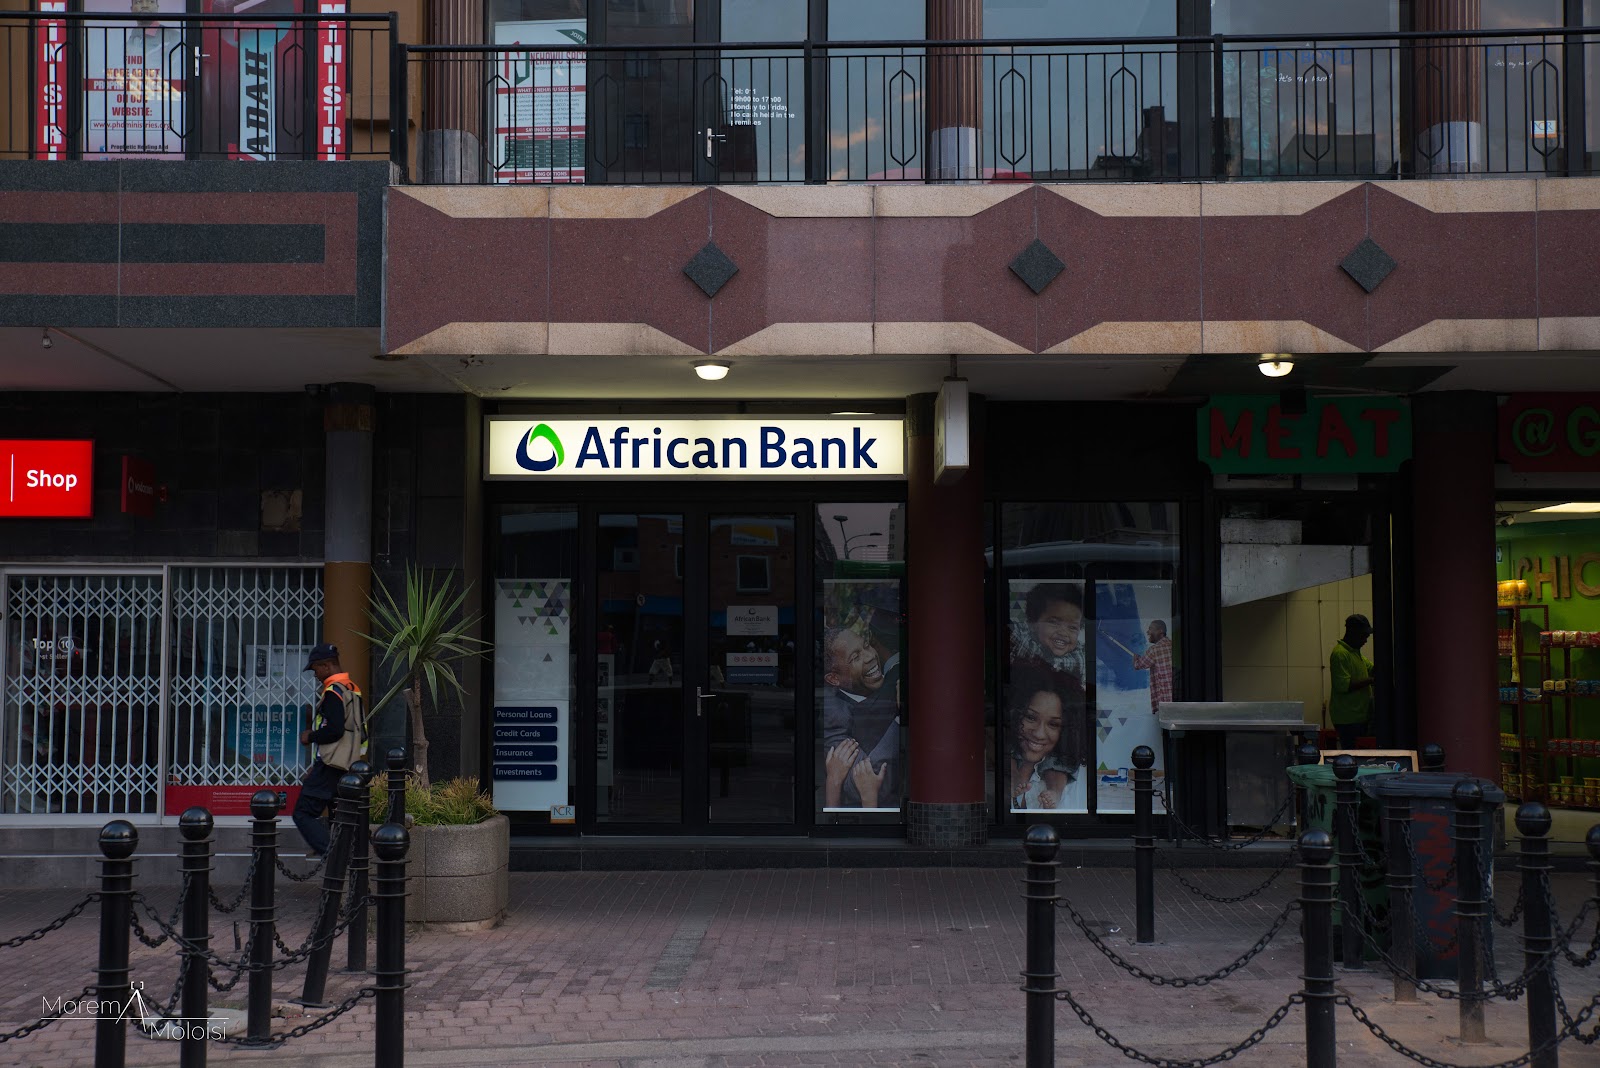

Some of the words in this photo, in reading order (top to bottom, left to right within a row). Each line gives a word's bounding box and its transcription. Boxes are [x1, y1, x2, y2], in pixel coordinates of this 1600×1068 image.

[124, 56, 143, 65] IND
[93, 121, 171, 131] www.phdminisries.org
[1210, 403, 1400, 459] MEAT
[574, 425, 748, 469] African
[759, 425, 878, 469] Bank
[26, 469, 78, 492] Shop
[495, 767, 542, 776] Investments
